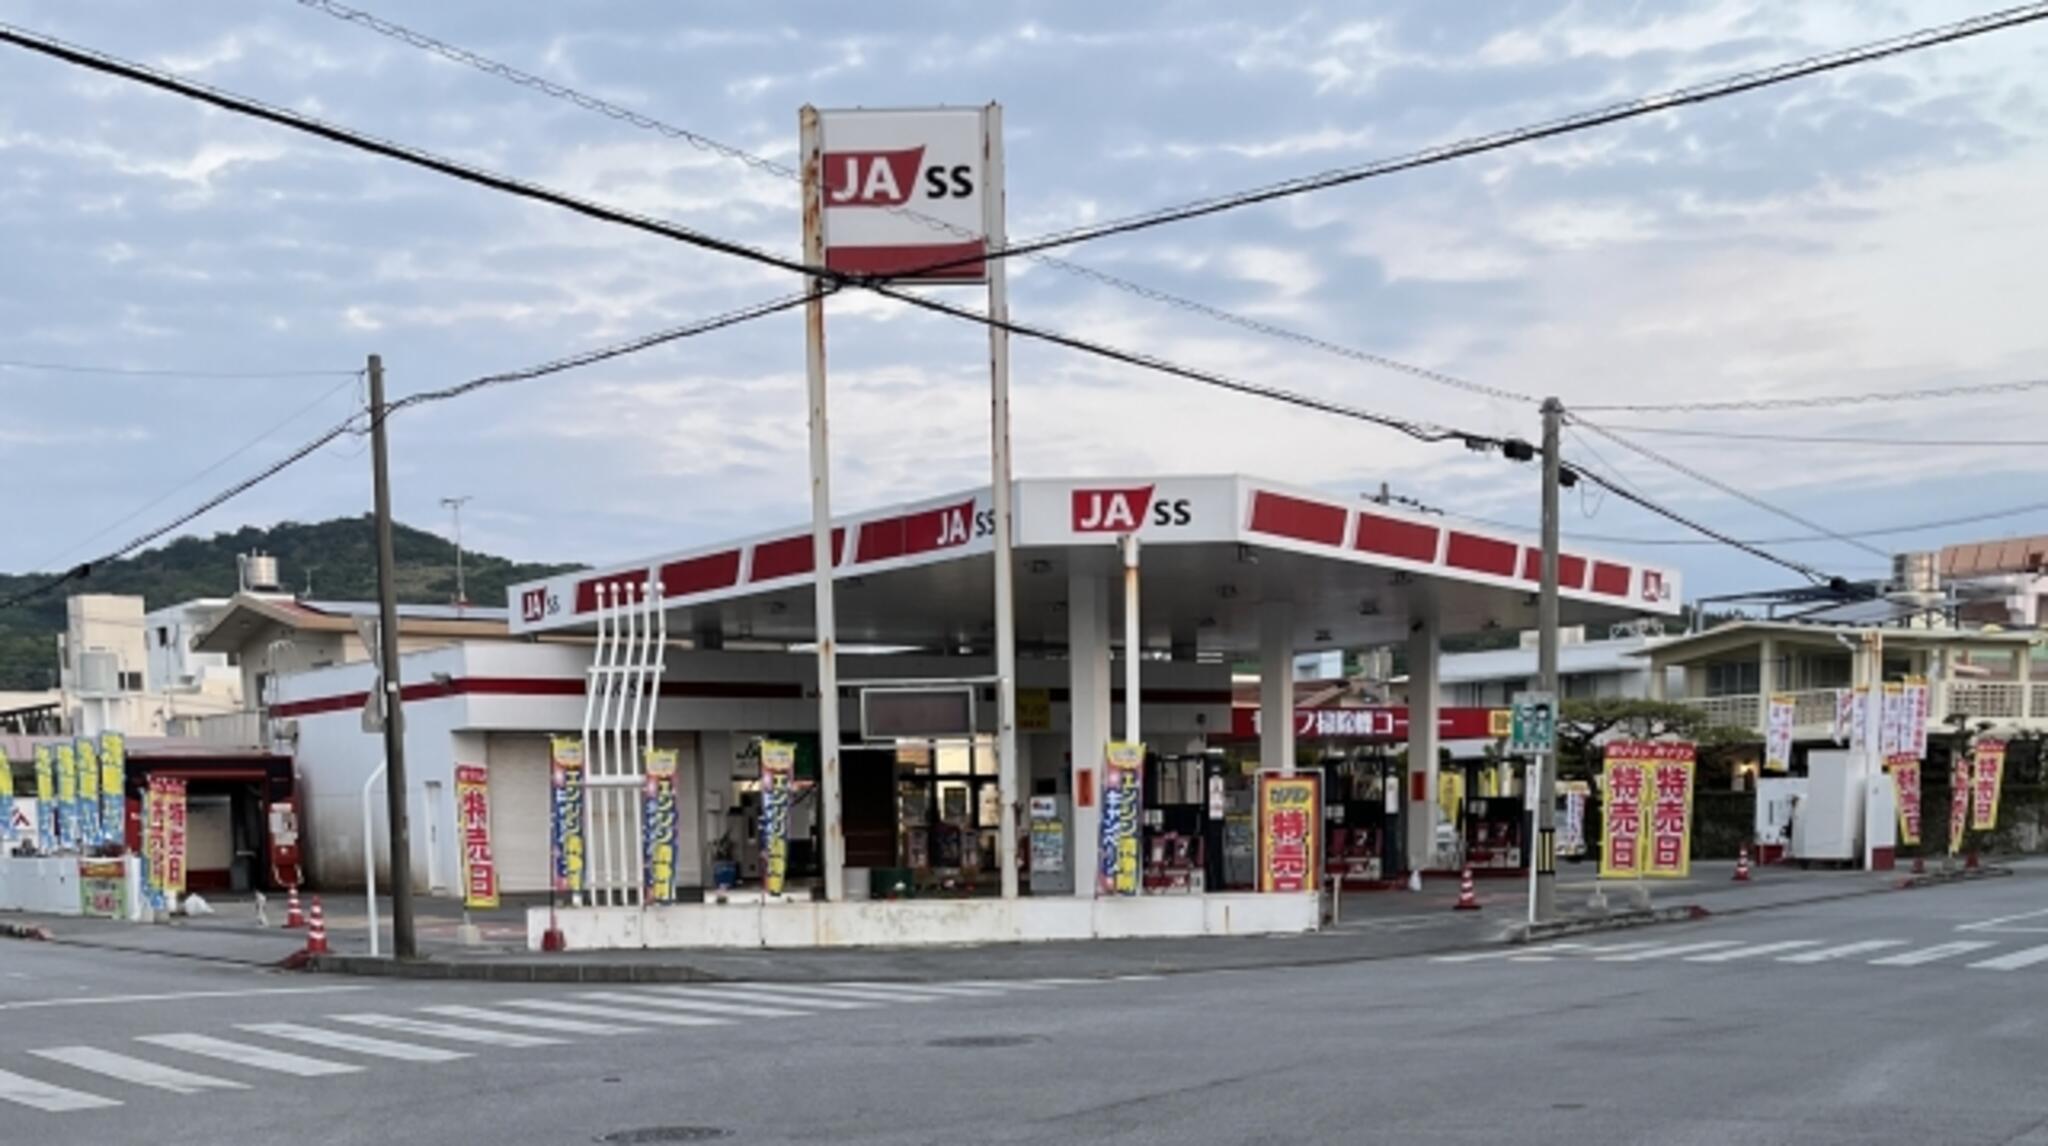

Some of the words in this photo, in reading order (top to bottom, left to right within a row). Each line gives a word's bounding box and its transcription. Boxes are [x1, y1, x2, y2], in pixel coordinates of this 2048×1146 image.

[831, 156, 901, 201] JA
[925, 165, 974, 199] SS
[936, 508, 967, 546] JA
[975, 508, 997, 538] SS
[1080, 493, 1135, 528] JA
[1154, 499, 1192, 527] SS
[523, 591, 543, 618] JA
[1251, 708, 1454, 736] フ掃除機コーー
[1610, 766, 1642, 868] 特売日
[1656, 765, 1688, 866] 特売日
[463, 790, 493, 897] 特売日
